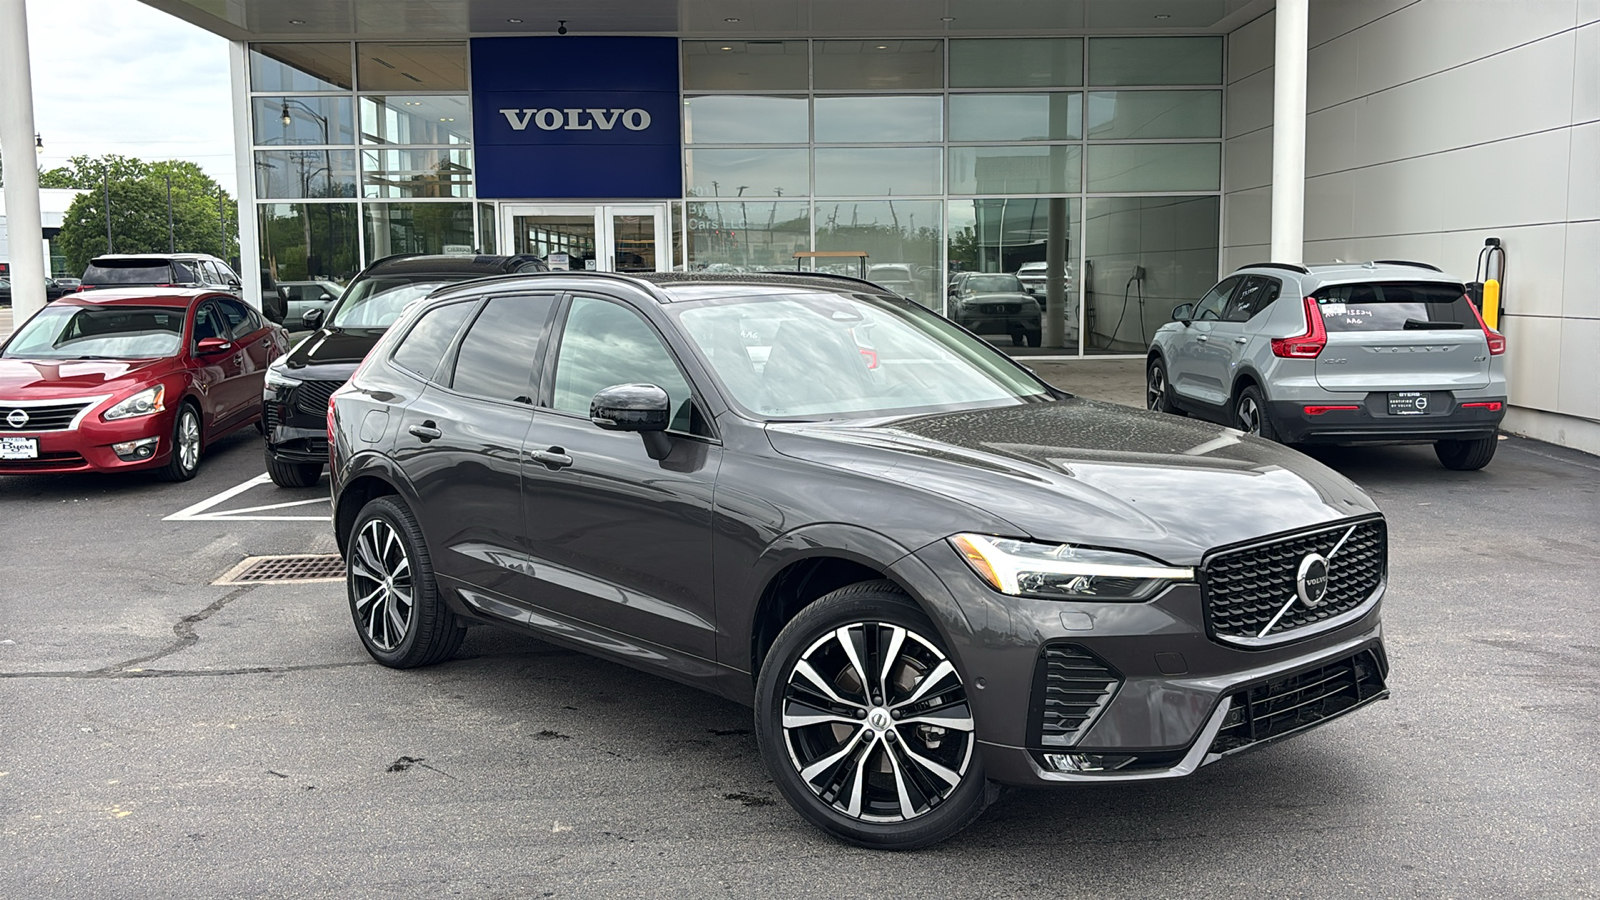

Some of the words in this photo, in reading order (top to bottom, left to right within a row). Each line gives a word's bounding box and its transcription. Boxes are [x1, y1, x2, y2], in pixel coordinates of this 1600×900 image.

[499, 108, 651, 131] VOLVO
[688, 218, 719, 229] Cars
[2, 442, 33, 452] Byers
